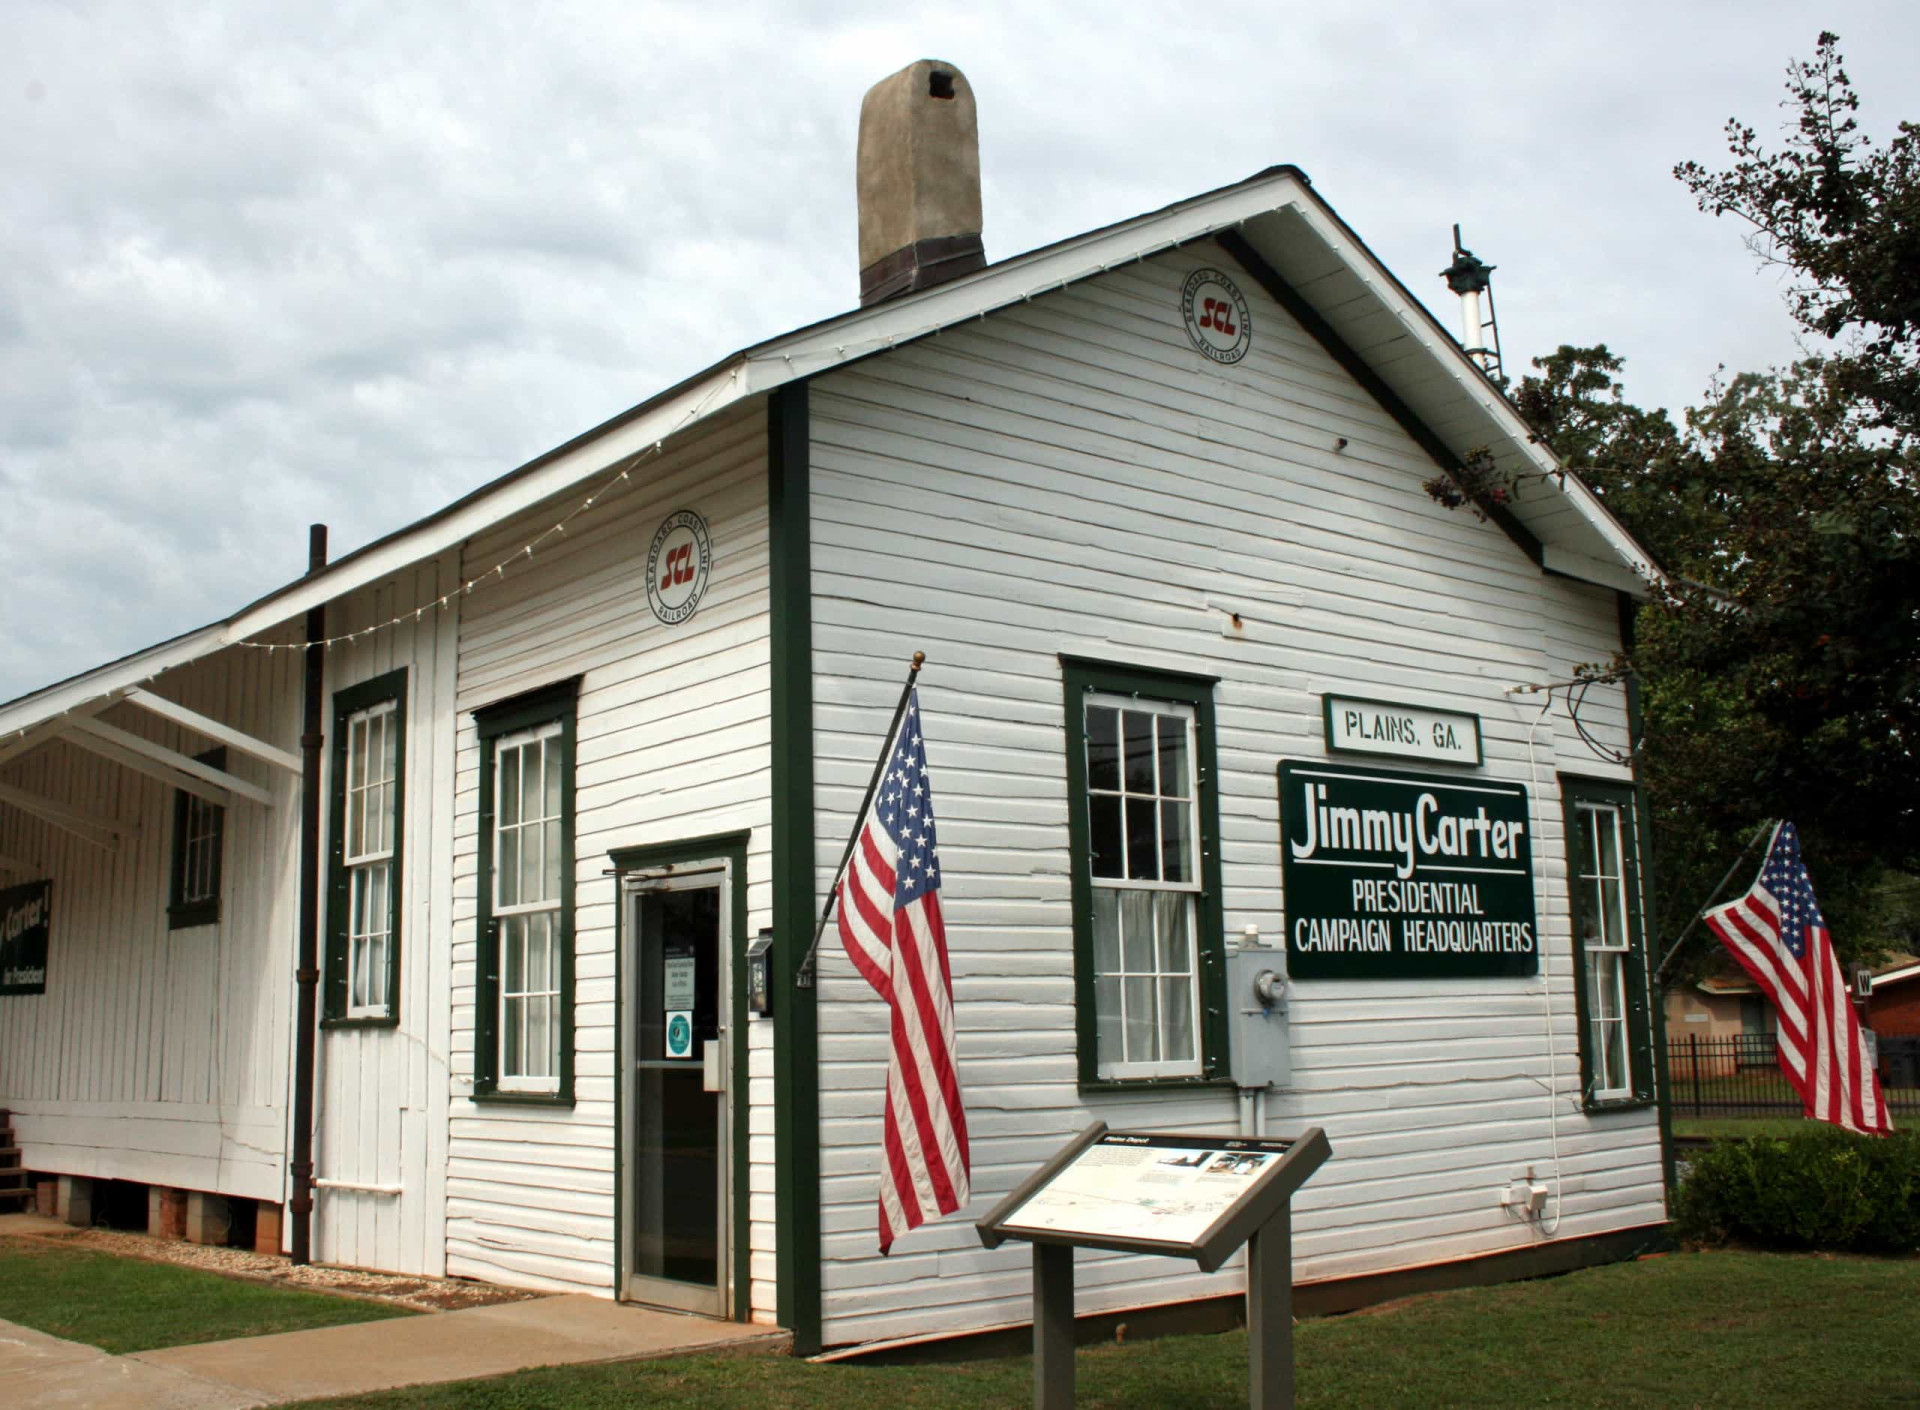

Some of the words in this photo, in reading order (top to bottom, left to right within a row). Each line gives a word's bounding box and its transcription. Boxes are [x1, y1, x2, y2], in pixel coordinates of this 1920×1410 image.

[1213, 273, 1243, 302] COAST
[1199, 297, 1236, 336] SCL
[1198, 337, 1242, 361] RAILROAD
[648, 519, 673, 594] SEABOARD
[677, 514, 703, 535] COAST
[700, 540, 709, 574] LINE
[660, 541, 695, 591] SCL
[658, 593, 698, 622] RAILROAD
[1433, 722, 1462, 750] GA.
[1290, 782, 1414, 879] Jimmy
[1416, 793, 1523, 859] Carter
[1352, 879, 1484, 915] PRESIDENTIAL
[1295, 918, 1391, 953] CAMPAIGN
[1403, 920, 1533, 953] HEADQUARTERS
[13, 966, 45, 984] President
[1860, 974, 1870, 992] W
